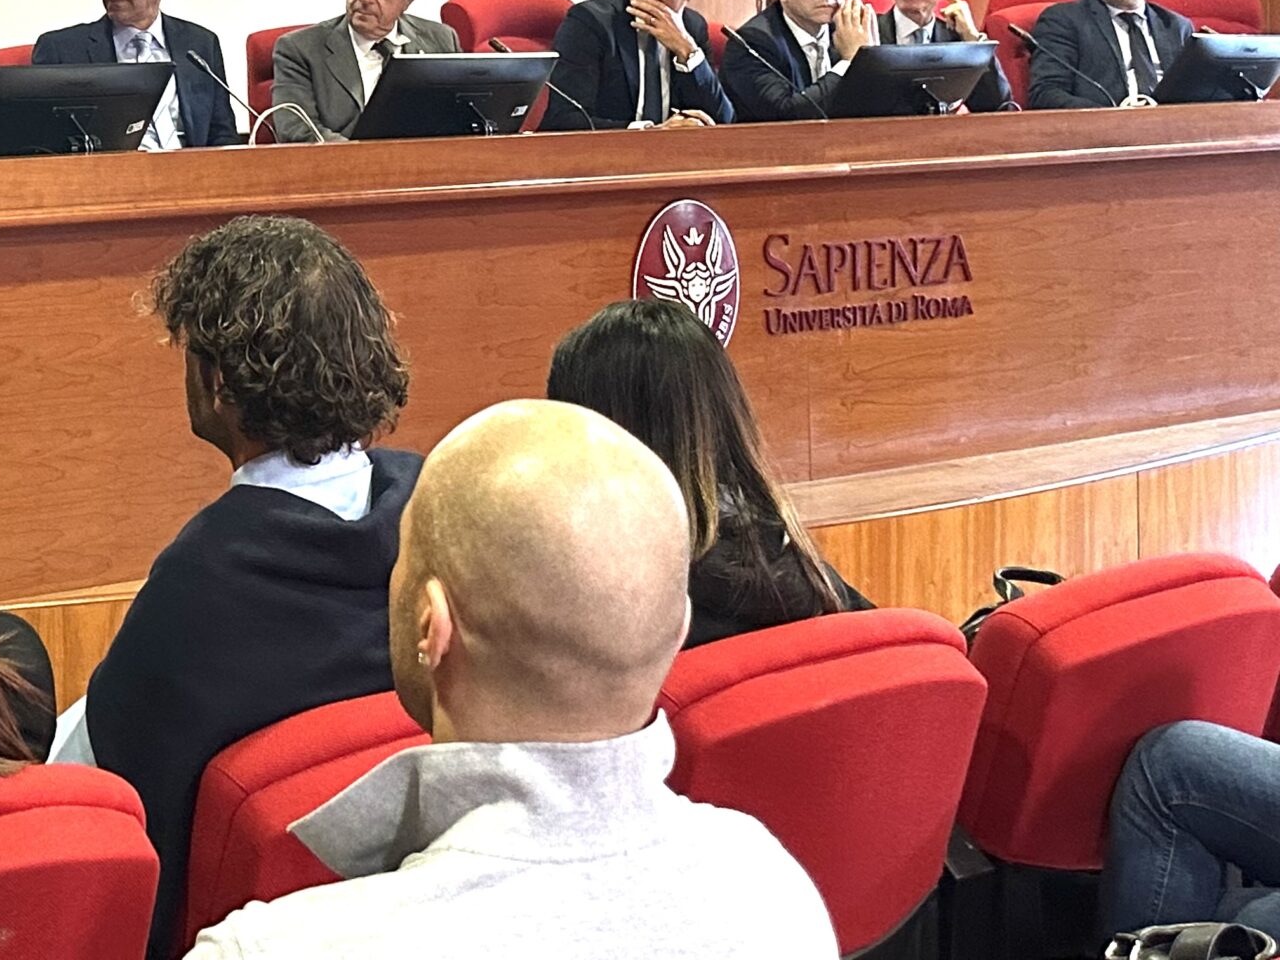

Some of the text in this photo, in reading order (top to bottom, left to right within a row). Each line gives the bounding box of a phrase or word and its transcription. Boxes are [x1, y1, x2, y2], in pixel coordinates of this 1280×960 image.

[763, 234, 972, 297] SAPIENZA
[887, 300, 908, 323] DI
[913, 294, 973, 320] ROMA
